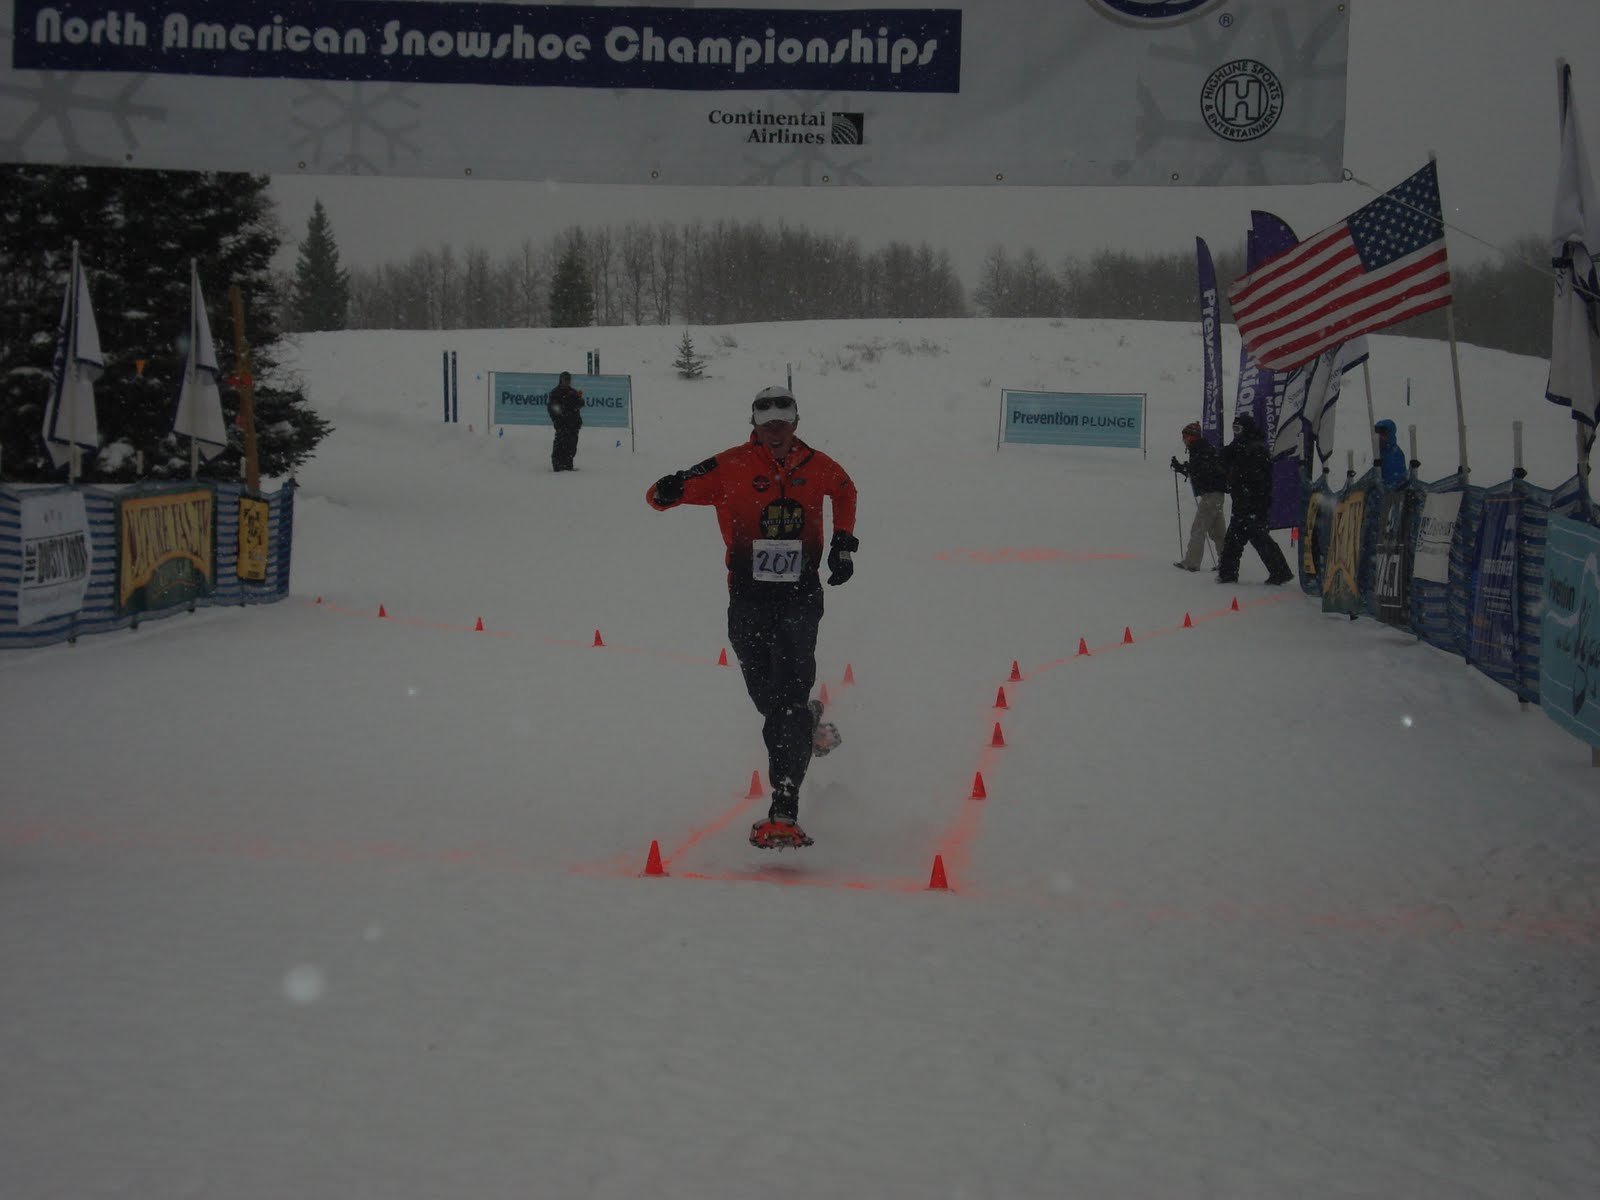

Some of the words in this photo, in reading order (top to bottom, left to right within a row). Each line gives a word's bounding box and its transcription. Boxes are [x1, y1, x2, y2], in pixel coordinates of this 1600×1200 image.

[36, 8, 147, 46] North
[163, 15, 366, 55] American
[381, 20, 591, 60] Snowshoe
[605, 26, 937, 73] Championships
[1204, 61, 1248, 100] HIGHLINE
[1251, 63, 1280, 100] SPORTS
[708, 110, 825, 126] Continental
[1208, 103, 1279, 138] ENTERTAINMENT
[747, 129, 825, 145] Airlines
[502, 391, 549, 406] Prevent
[586, 396, 623, 408] UNGE
[1013, 411, 1078, 427] Prevention
[1082, 416, 1135, 428] PLUNGE
[1265, 396, 1276, 452] MAGAZIN
[757, 551, 799, 574] 207
